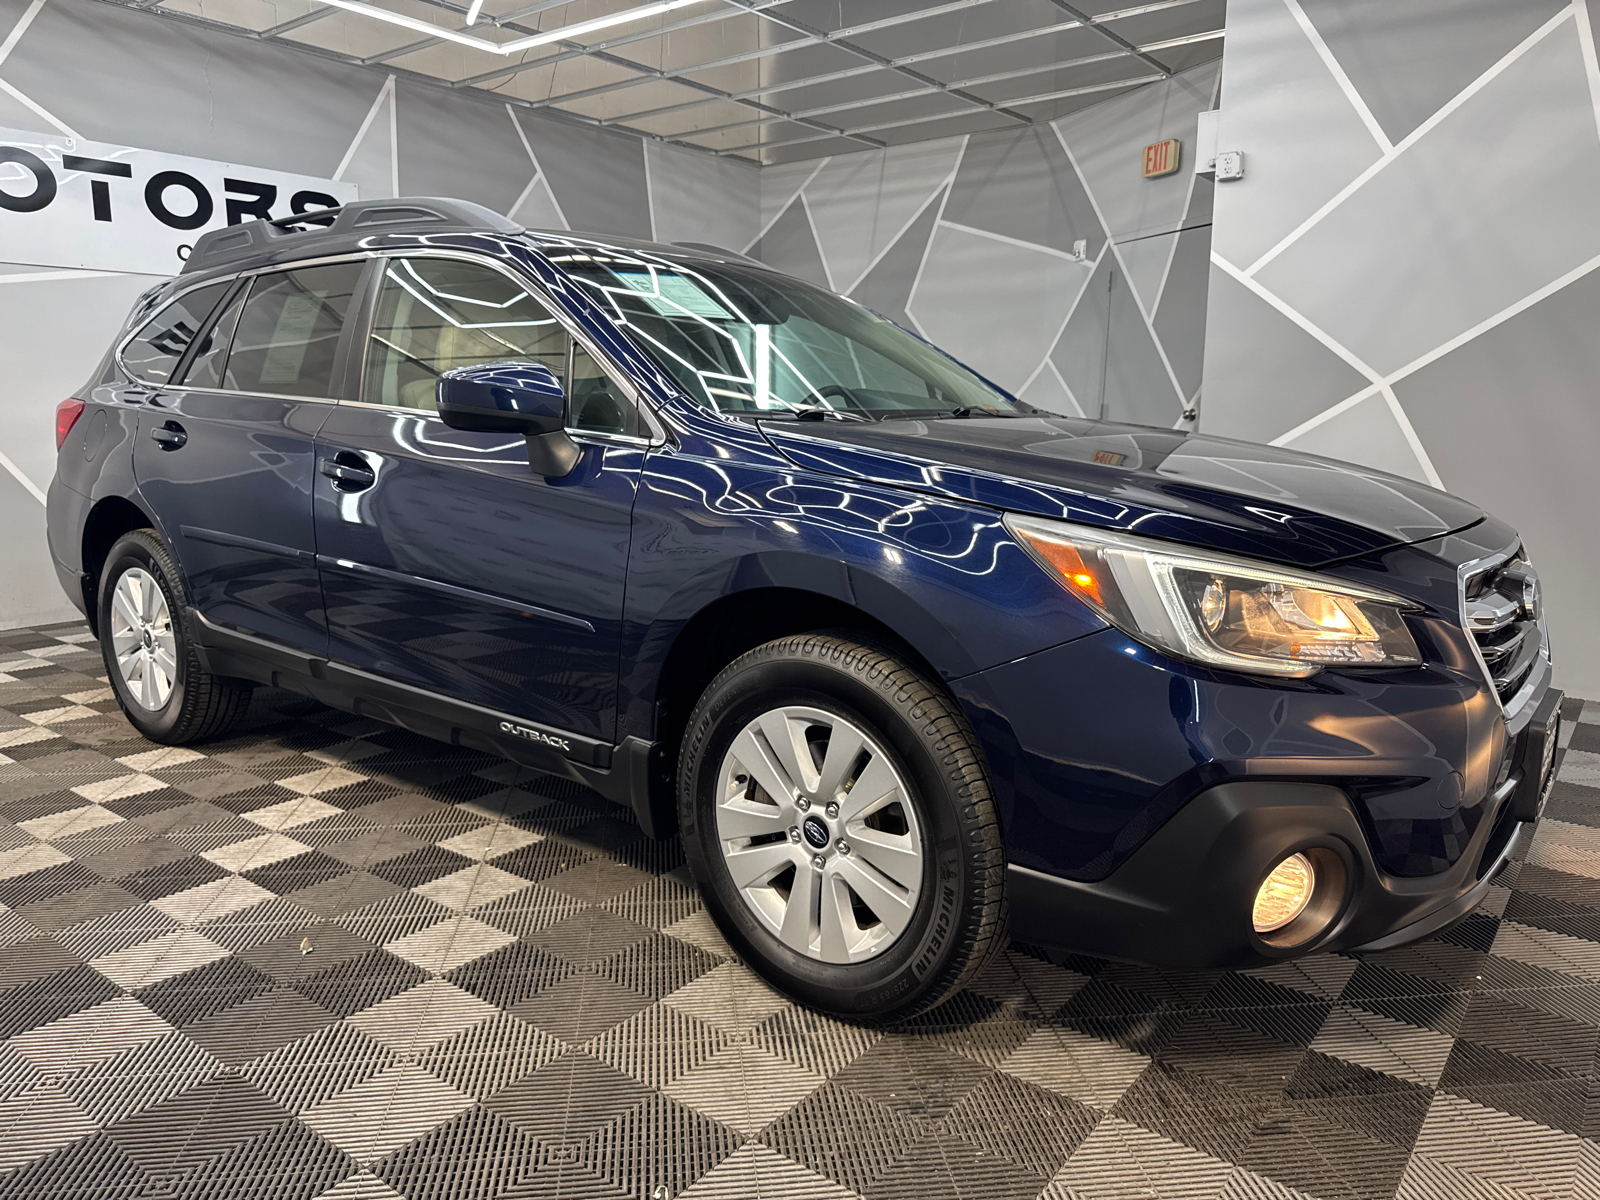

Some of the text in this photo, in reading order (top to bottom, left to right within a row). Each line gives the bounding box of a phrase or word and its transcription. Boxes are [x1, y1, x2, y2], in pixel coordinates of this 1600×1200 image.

[1145, 141, 1170, 175] EXIT
[499, 721, 570, 752] OUTBACK
[683, 711, 711, 797] MICHELIN
[914, 884, 955, 977] MICHELIN
